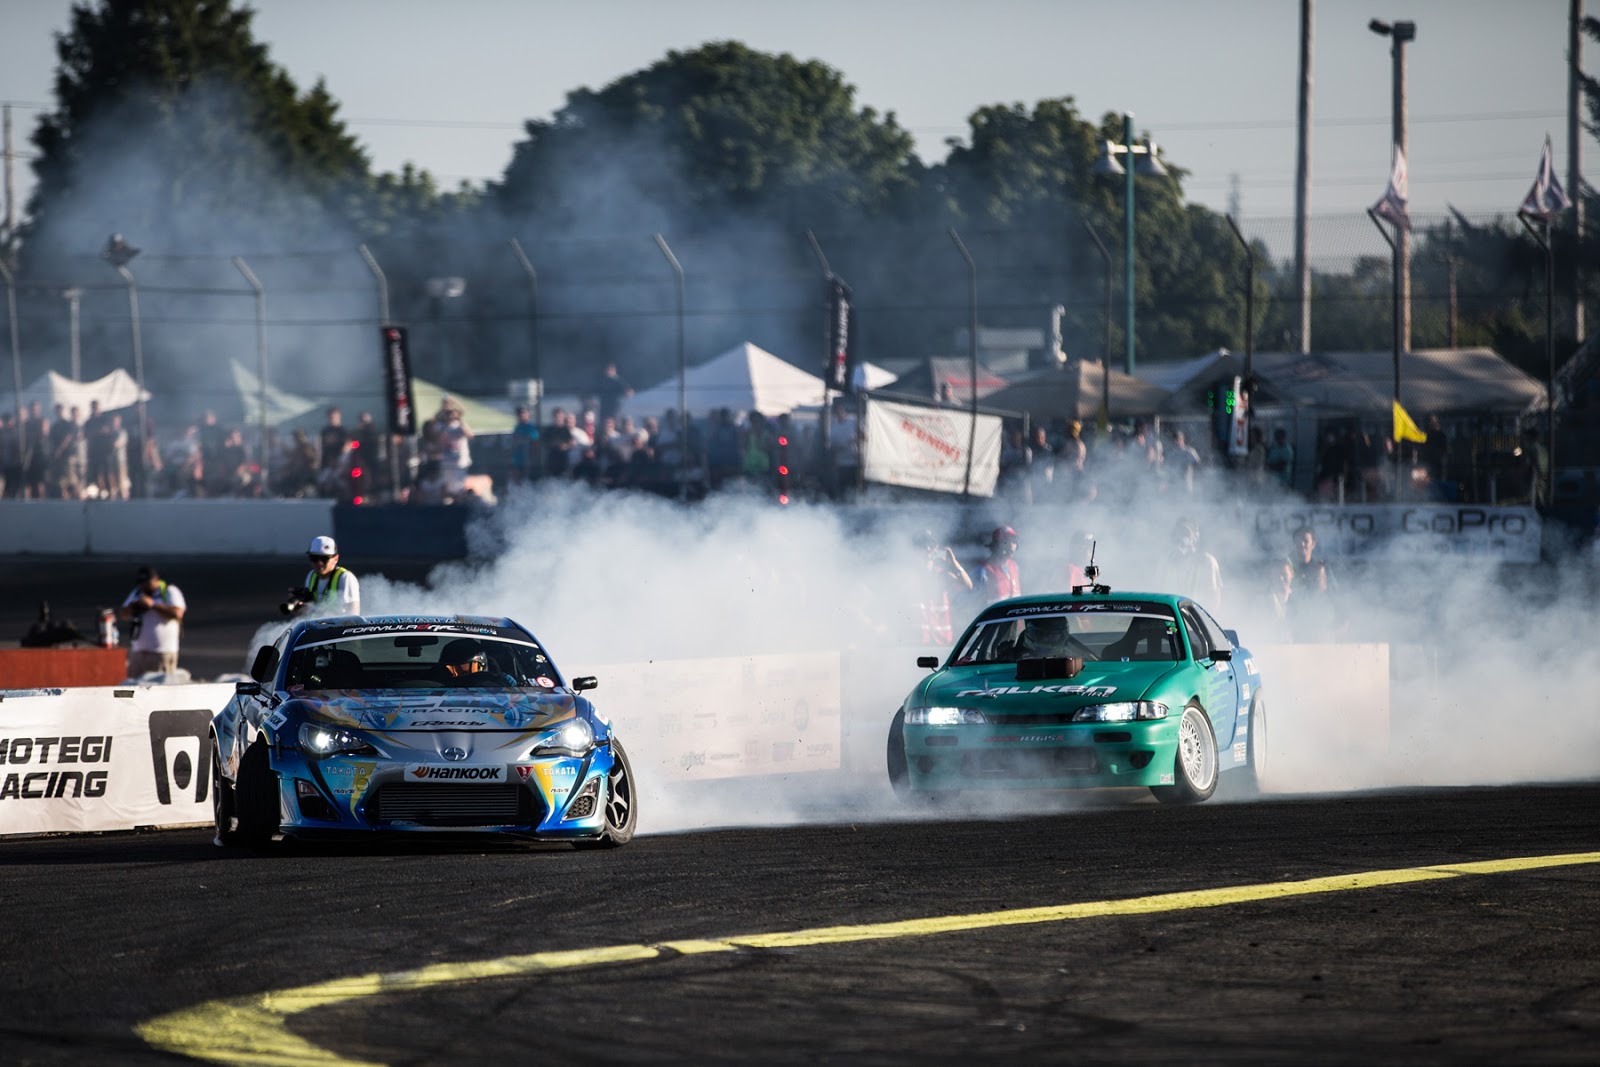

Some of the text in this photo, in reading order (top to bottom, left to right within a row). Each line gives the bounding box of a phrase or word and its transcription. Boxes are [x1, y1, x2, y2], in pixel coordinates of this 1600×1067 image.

[1256, 508, 1526, 534] GoPro GoPro
[1006, 605, 1072, 615] FORMULA
[342, 625, 417, 635] FORMULA
[956, 685, 1117, 698] FALKEN
[326, 766, 366, 775] TAKATA
[542, 767, 576, 776] TAKATA
[0, 770, 108, 800] ACING
